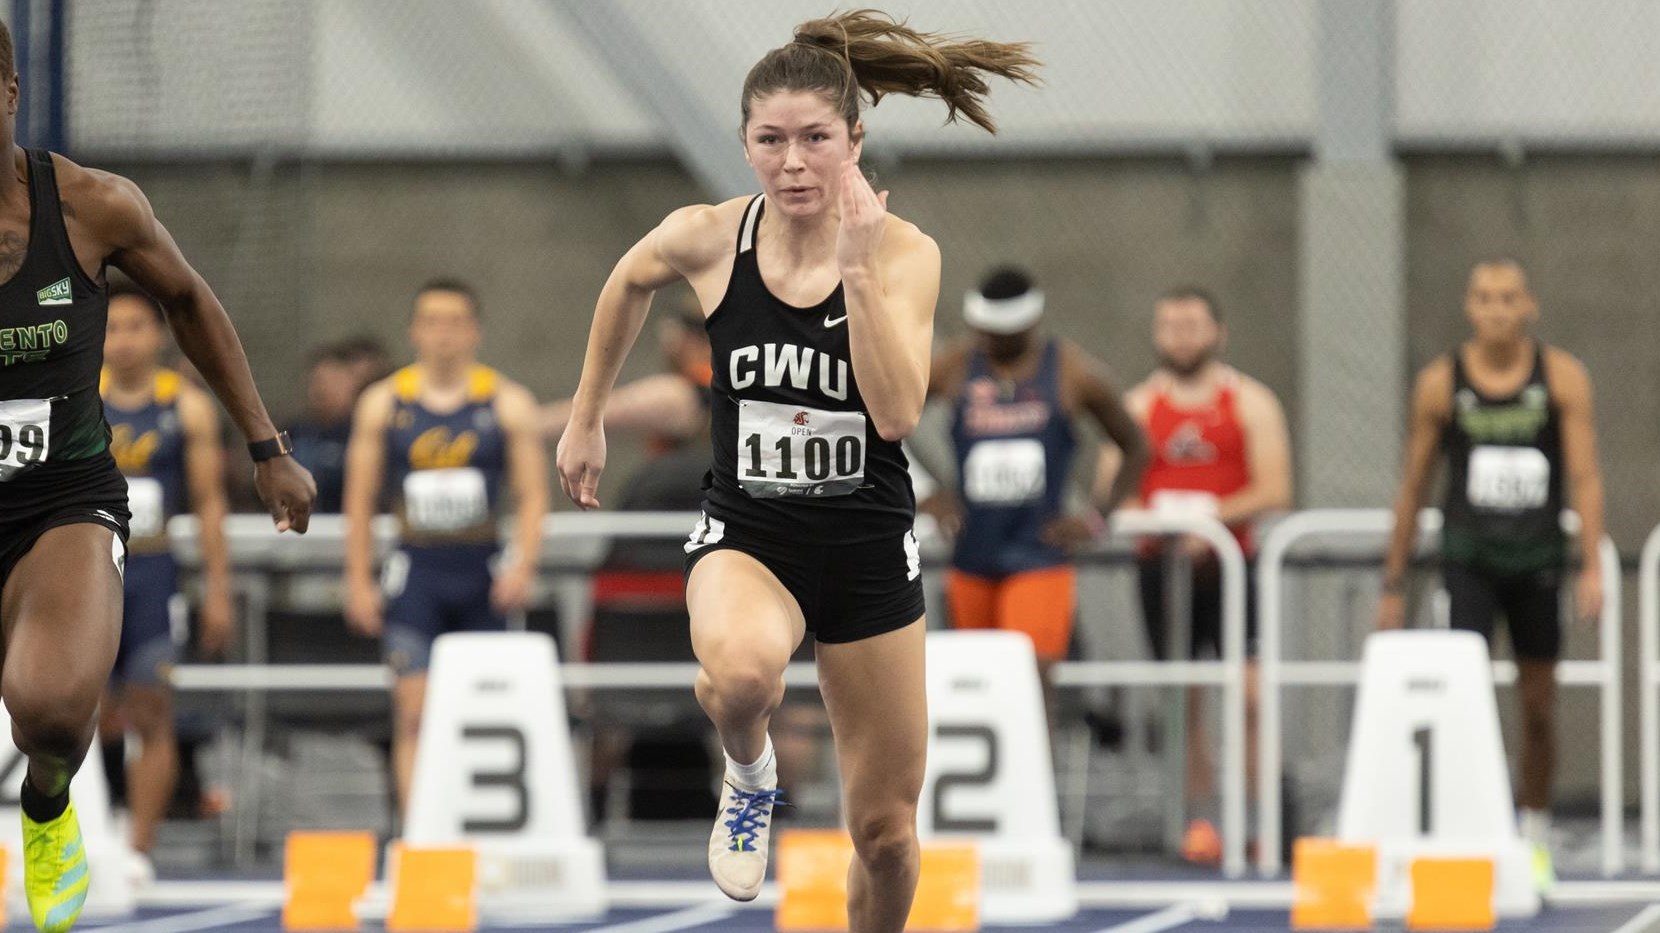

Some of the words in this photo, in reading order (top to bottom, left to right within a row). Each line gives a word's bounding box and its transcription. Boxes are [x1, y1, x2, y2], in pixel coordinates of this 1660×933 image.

[729, 343, 847, 401] CWU
[745, 433, 861, 480] 1100
[791, 427, 812, 436] OPEN
[460, 725, 530, 834] 3
[933, 724, 1000, 832] 2
[1412, 725, 1434, 836] 1
